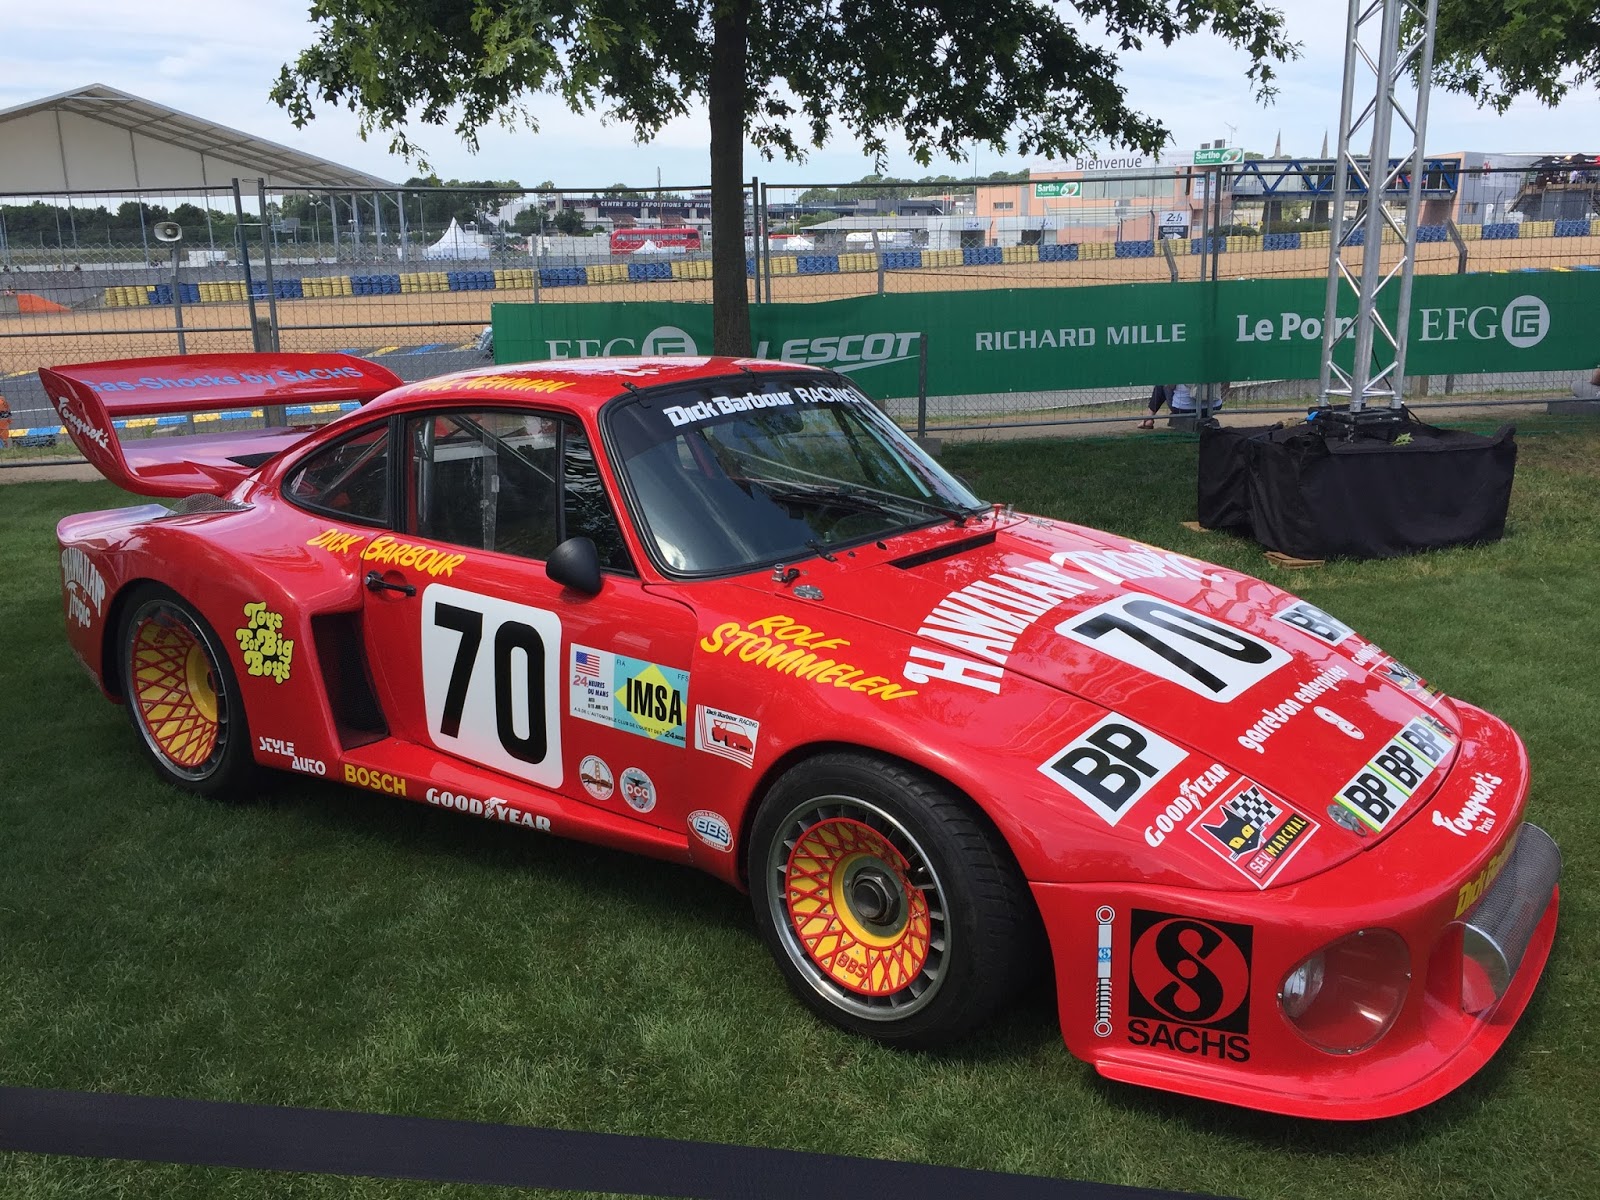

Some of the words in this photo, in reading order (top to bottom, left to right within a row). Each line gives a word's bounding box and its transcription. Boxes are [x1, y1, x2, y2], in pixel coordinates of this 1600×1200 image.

[1075, 156, 1142, 171] Bienvenue
[1195, 151, 1220, 160] Sarthe
[1037, 183, 1060, 192] Sarthe
[975, 327, 1096, 351] RICHARD
[1106, 323, 1187, 345] MILLE
[1236, 314, 1274, 342] Le
[1279, 312, 1357, 341] Pon
[1418, 306, 1498, 342] EFG
[756, 332, 922, 364] LESCOT
[240, 372, 279, 387] by
[276, 366, 364, 382] SACHS
[662, 399, 722, 428] Dick
[711, 391, 795, 415] Barbour
[794, 387, 860, 404] RACING
[306, 528, 365, 555] DICK
[360, 536, 467, 578] BARBOUR
[243, 601, 284, 633] Toys
[748, 615, 851, 651] ROLF
[902, 561, 1100, 695] HAWAIIAN
[1278, 604, 1349, 642] BP
[616, 659, 626, 667] FIA
[700, 622, 919, 701] STOMMELEN
[1071, 599, 1273, 694] 70
[243, 650, 292, 685] Boys
[434, 601, 548, 765] 70
[572, 674, 589, 688] 24
[626, 677, 683, 726] IMSA
[291, 755, 327, 776] AUTO
[344, 764, 407, 797] BOSCH
[1050, 723, 1160, 813] BP
[1342, 772, 1397, 824] BP
[1374, 744, 1424, 790] BP
[1400, 723, 1446, 763] BP
[426, 788, 551, 832] GOODYEAR
[1144, 763, 1230, 848] GOODYEAR
[695, 816, 729, 844] BBS
[1264, 815, 1307, 858] MARCHAL
[836, 951, 868, 978] BBS
[1127, 1018, 1251, 1063] SACHS
